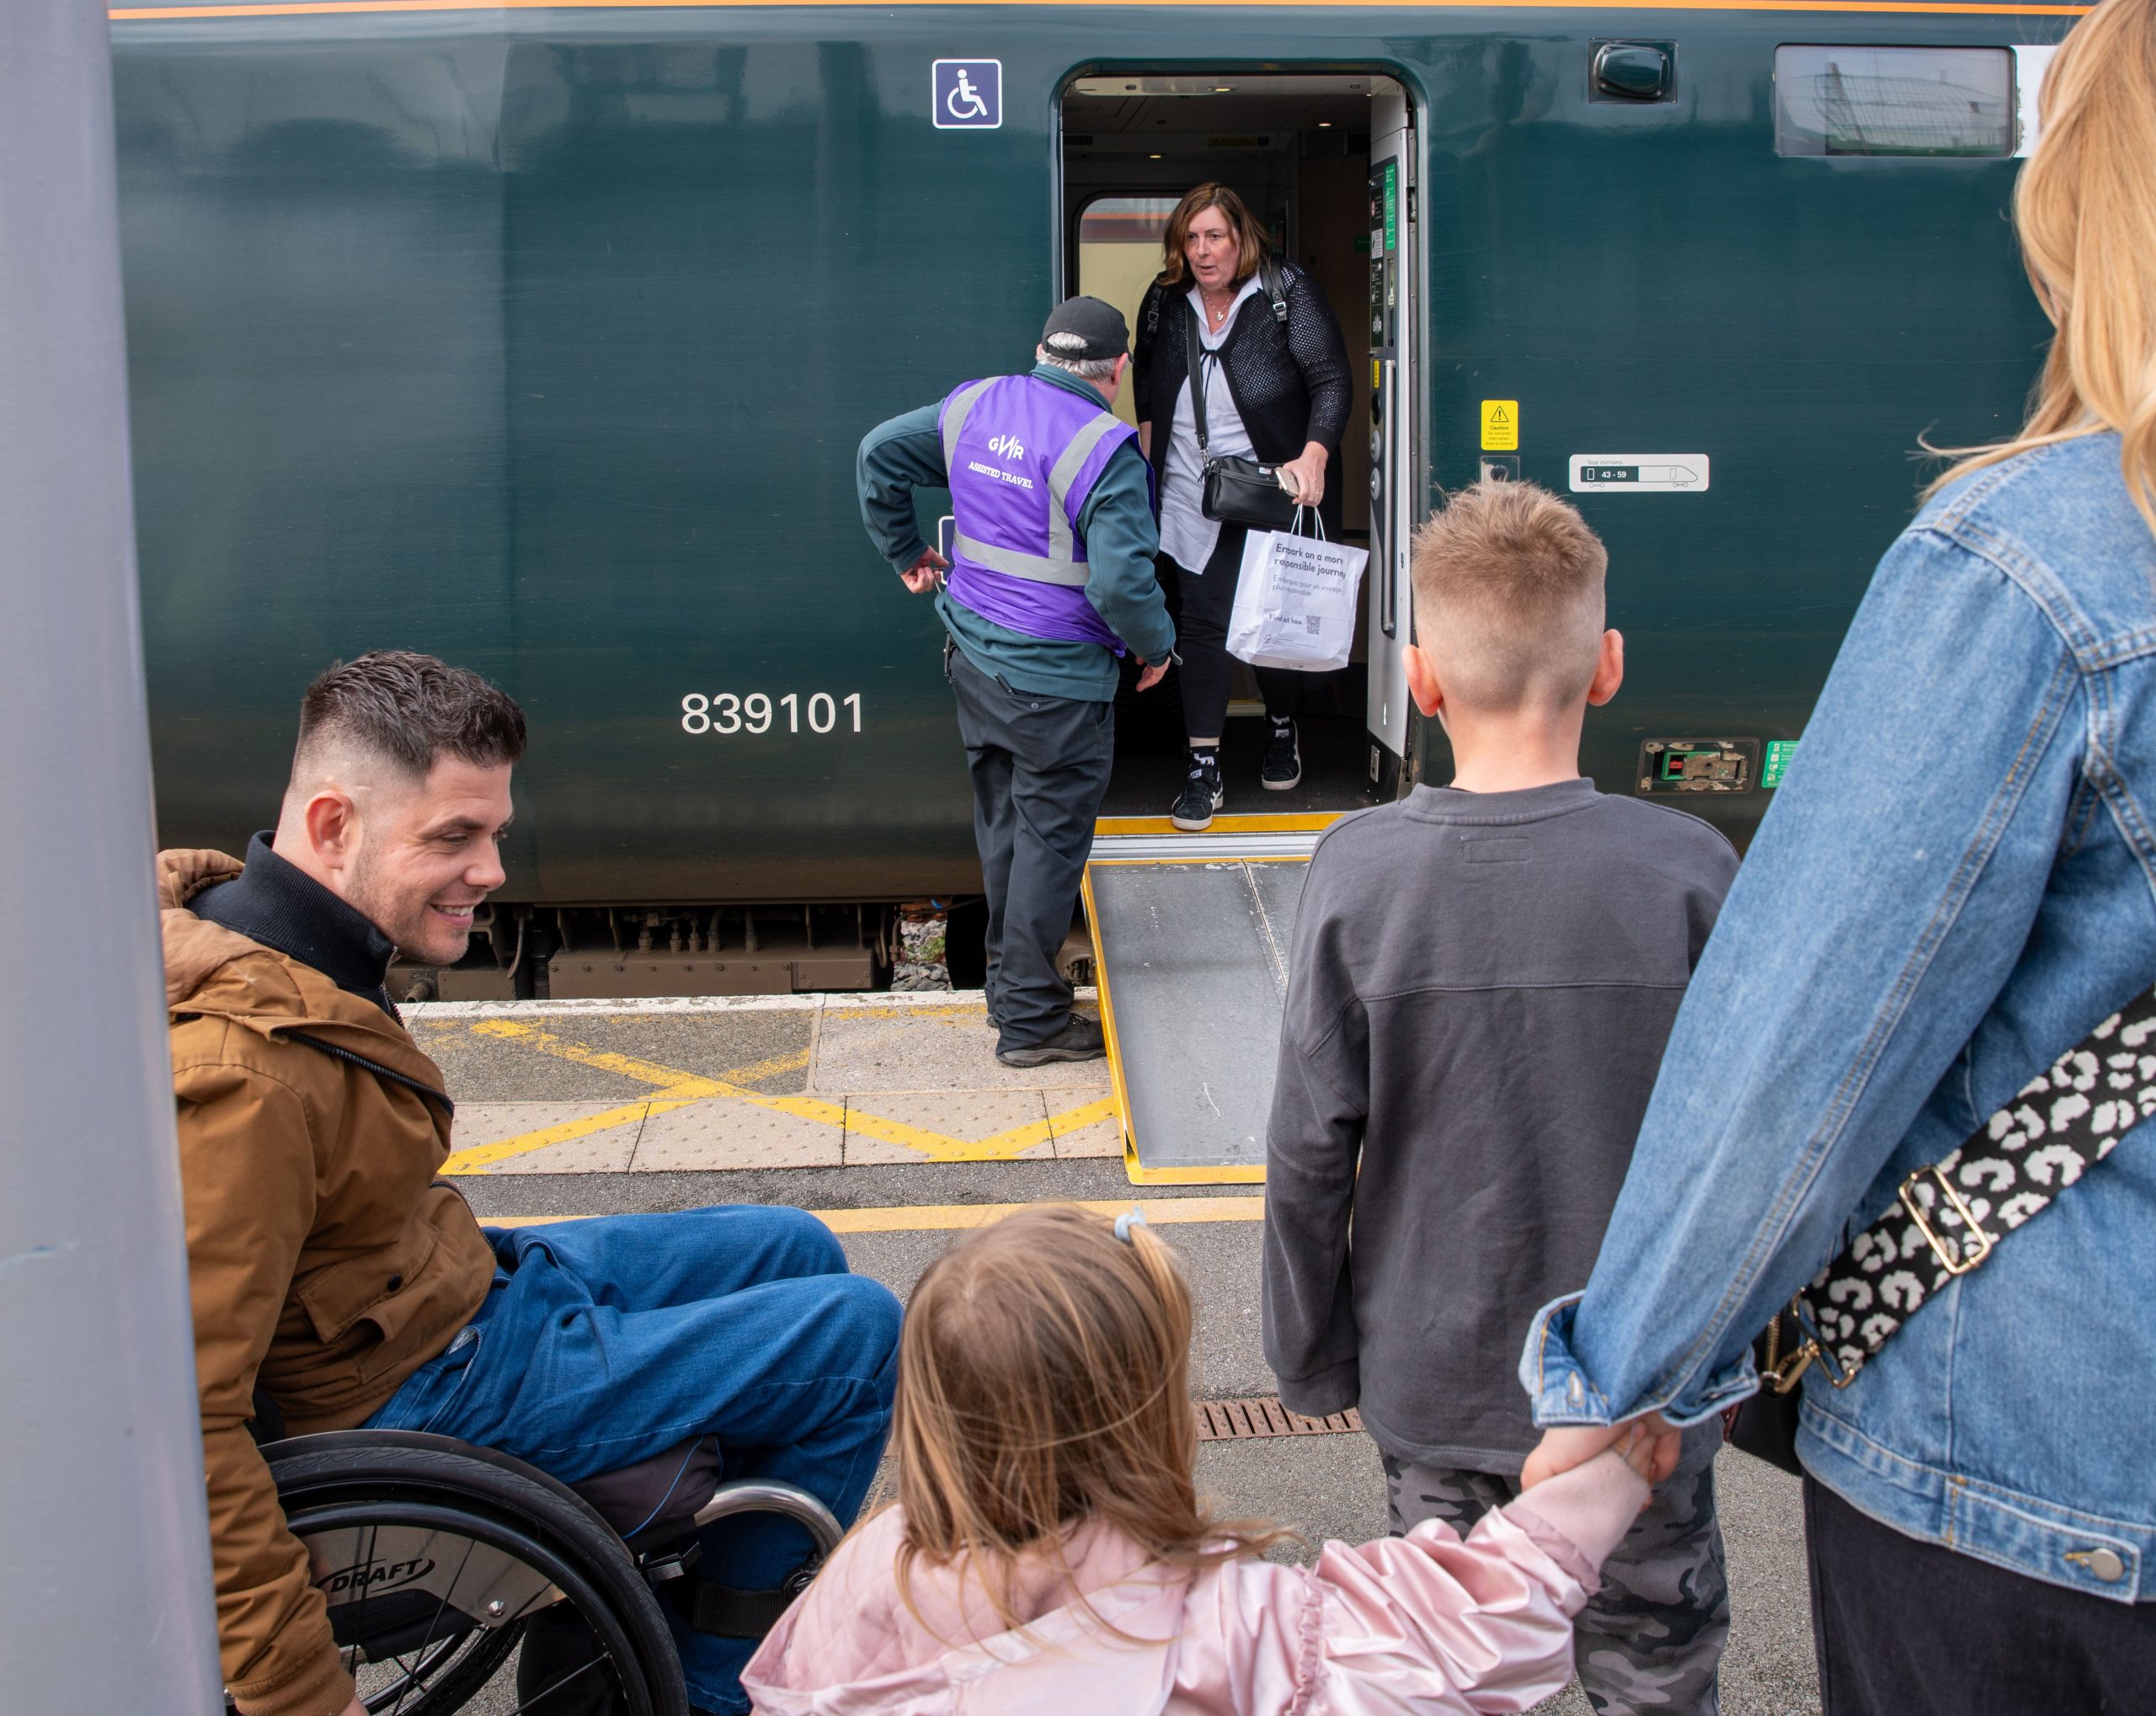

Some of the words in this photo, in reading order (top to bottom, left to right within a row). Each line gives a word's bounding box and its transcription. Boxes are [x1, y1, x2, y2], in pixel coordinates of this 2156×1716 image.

[988, 434, 1024, 461] GWR
[968, 461, 1001, 478] ASSISTED
[1001, 472, 1033, 489] TRAVEL
[1274, 558, 1315, 573] responsible
[1269, 614, 1283, 622] Find
[681, 692, 862, 734] 839101
[330, 1558, 423, 1593] DRAFT
